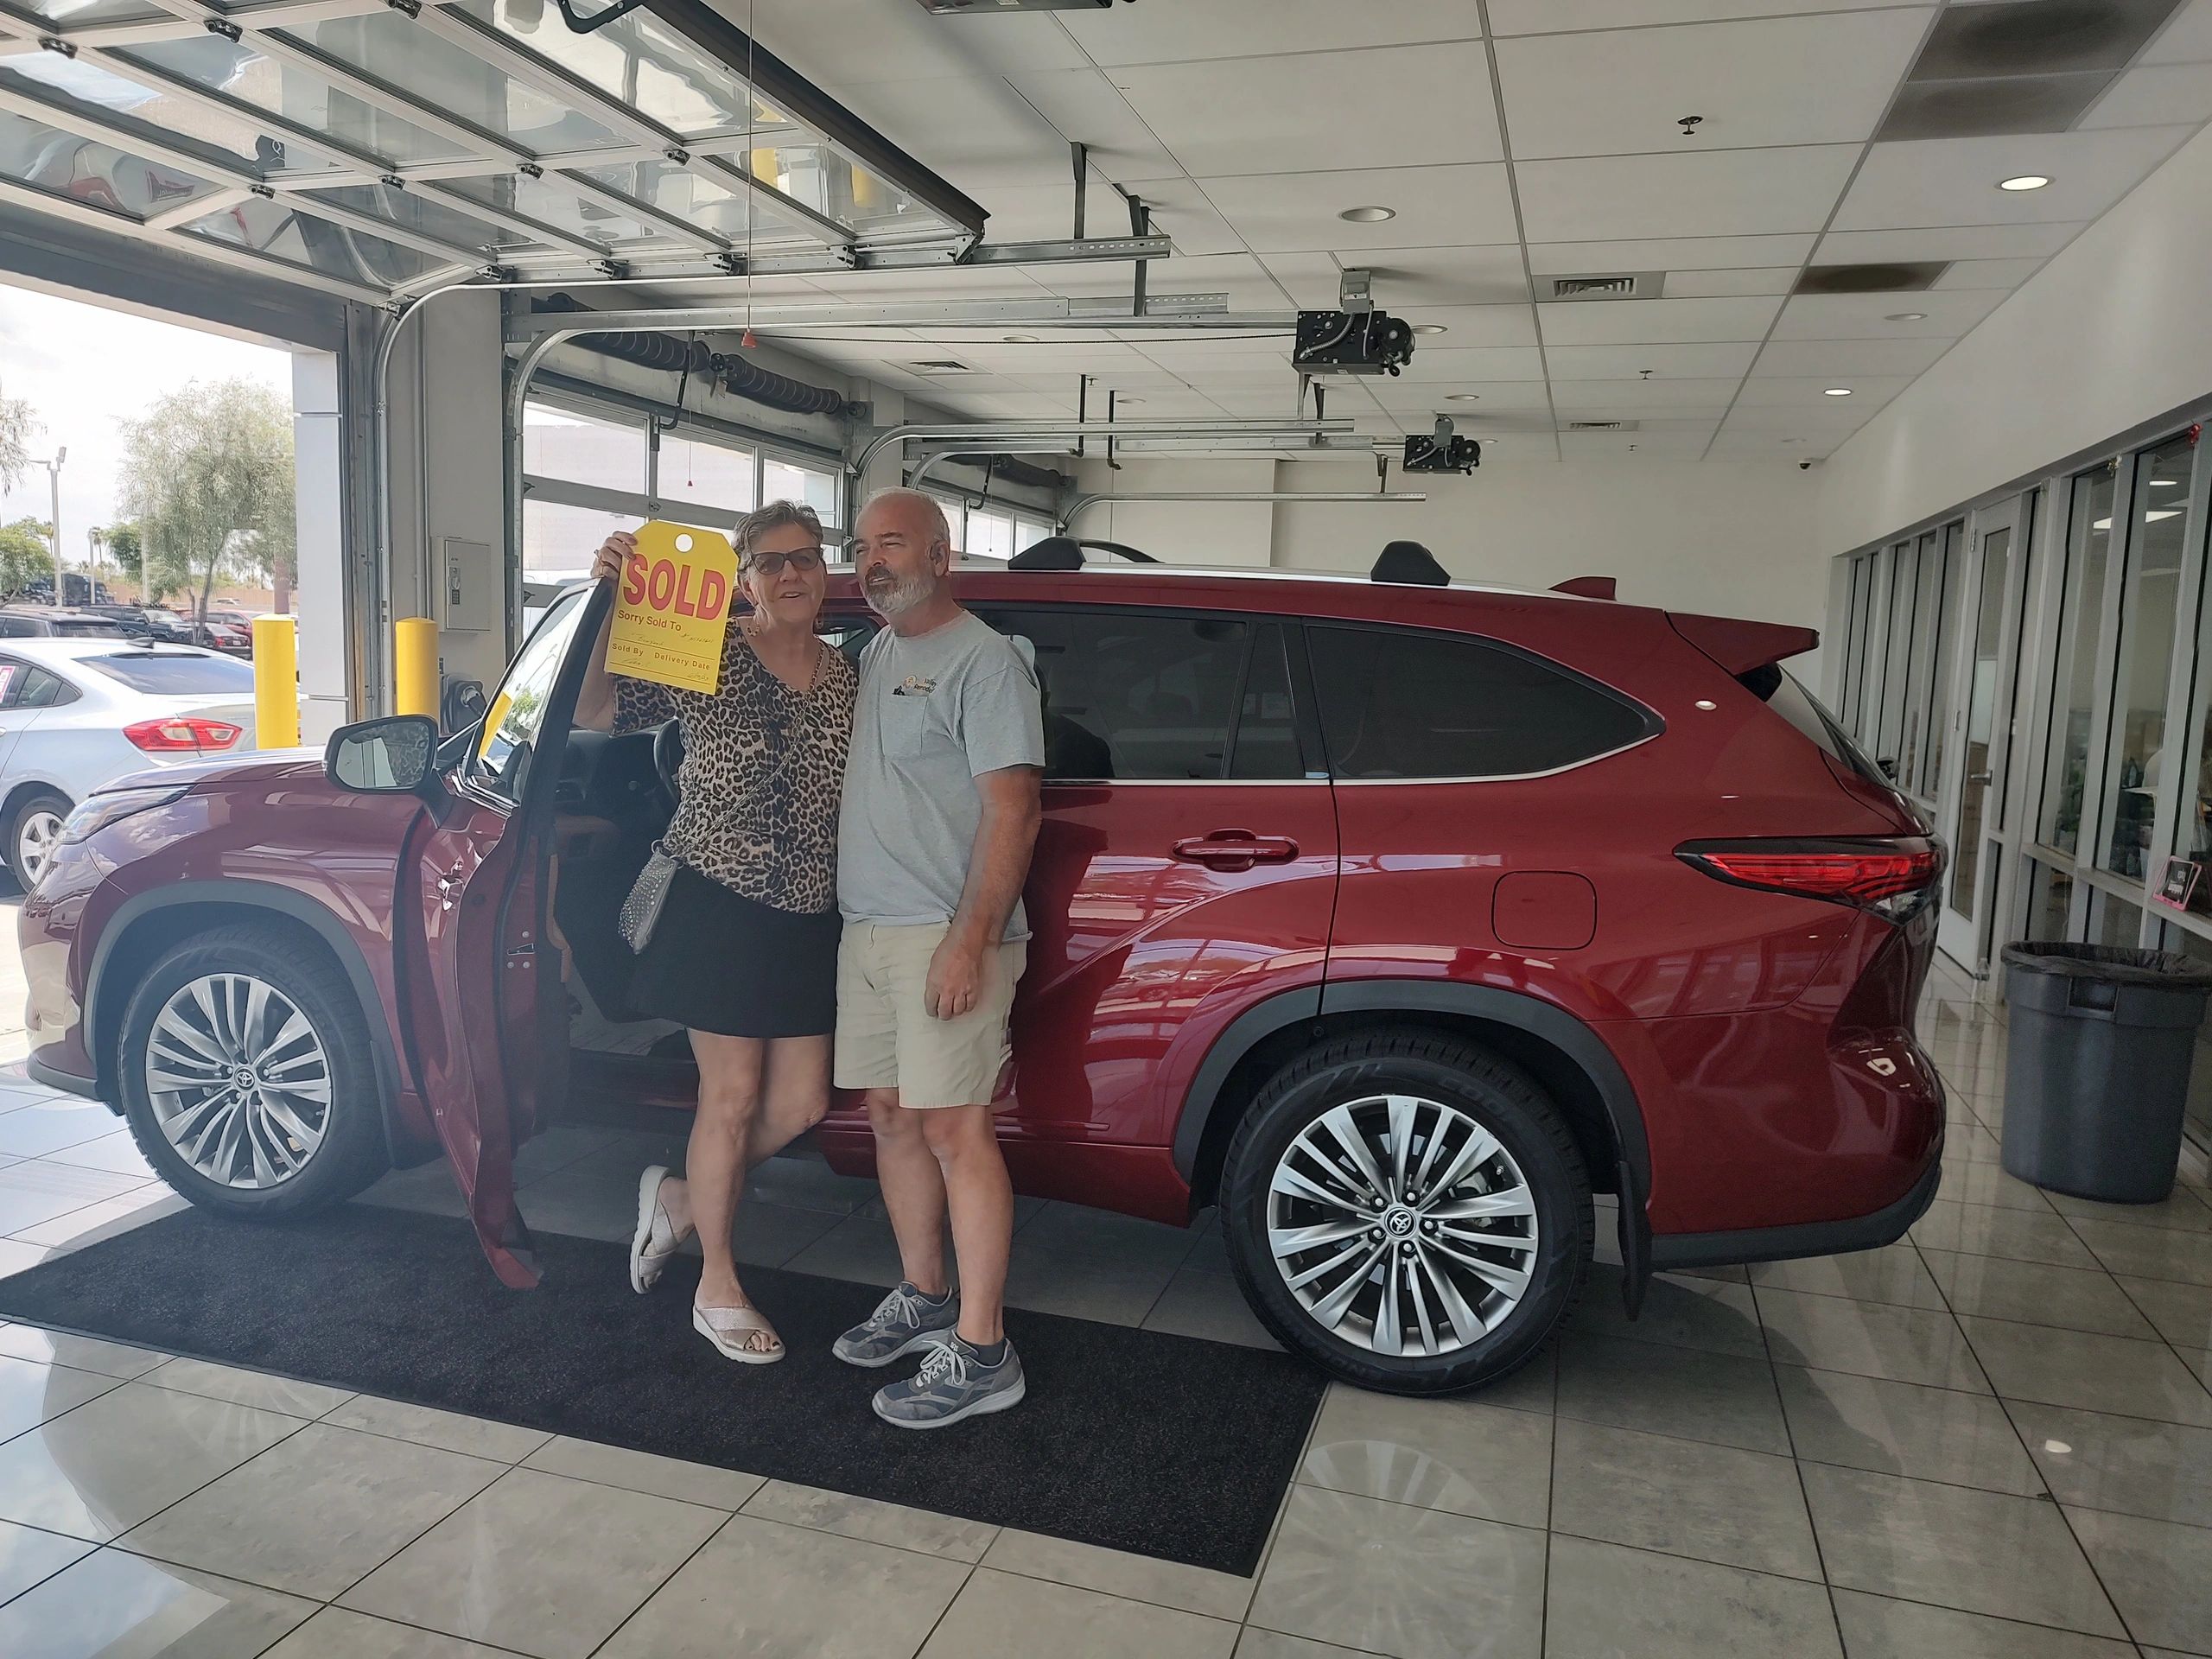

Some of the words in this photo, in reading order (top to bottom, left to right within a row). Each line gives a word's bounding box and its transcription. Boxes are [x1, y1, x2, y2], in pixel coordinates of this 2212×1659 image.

[623, 553, 726, 620] SOLD
[617, 609, 644, 625] Sorry
[646, 615, 667, 628] Sold
[670, 621, 682, 631] To
[612, 643, 631, 652] Sold
[633, 647, 644, 657] By
[654, 652, 690, 666] Delivery
[692, 660, 710, 671] Date
